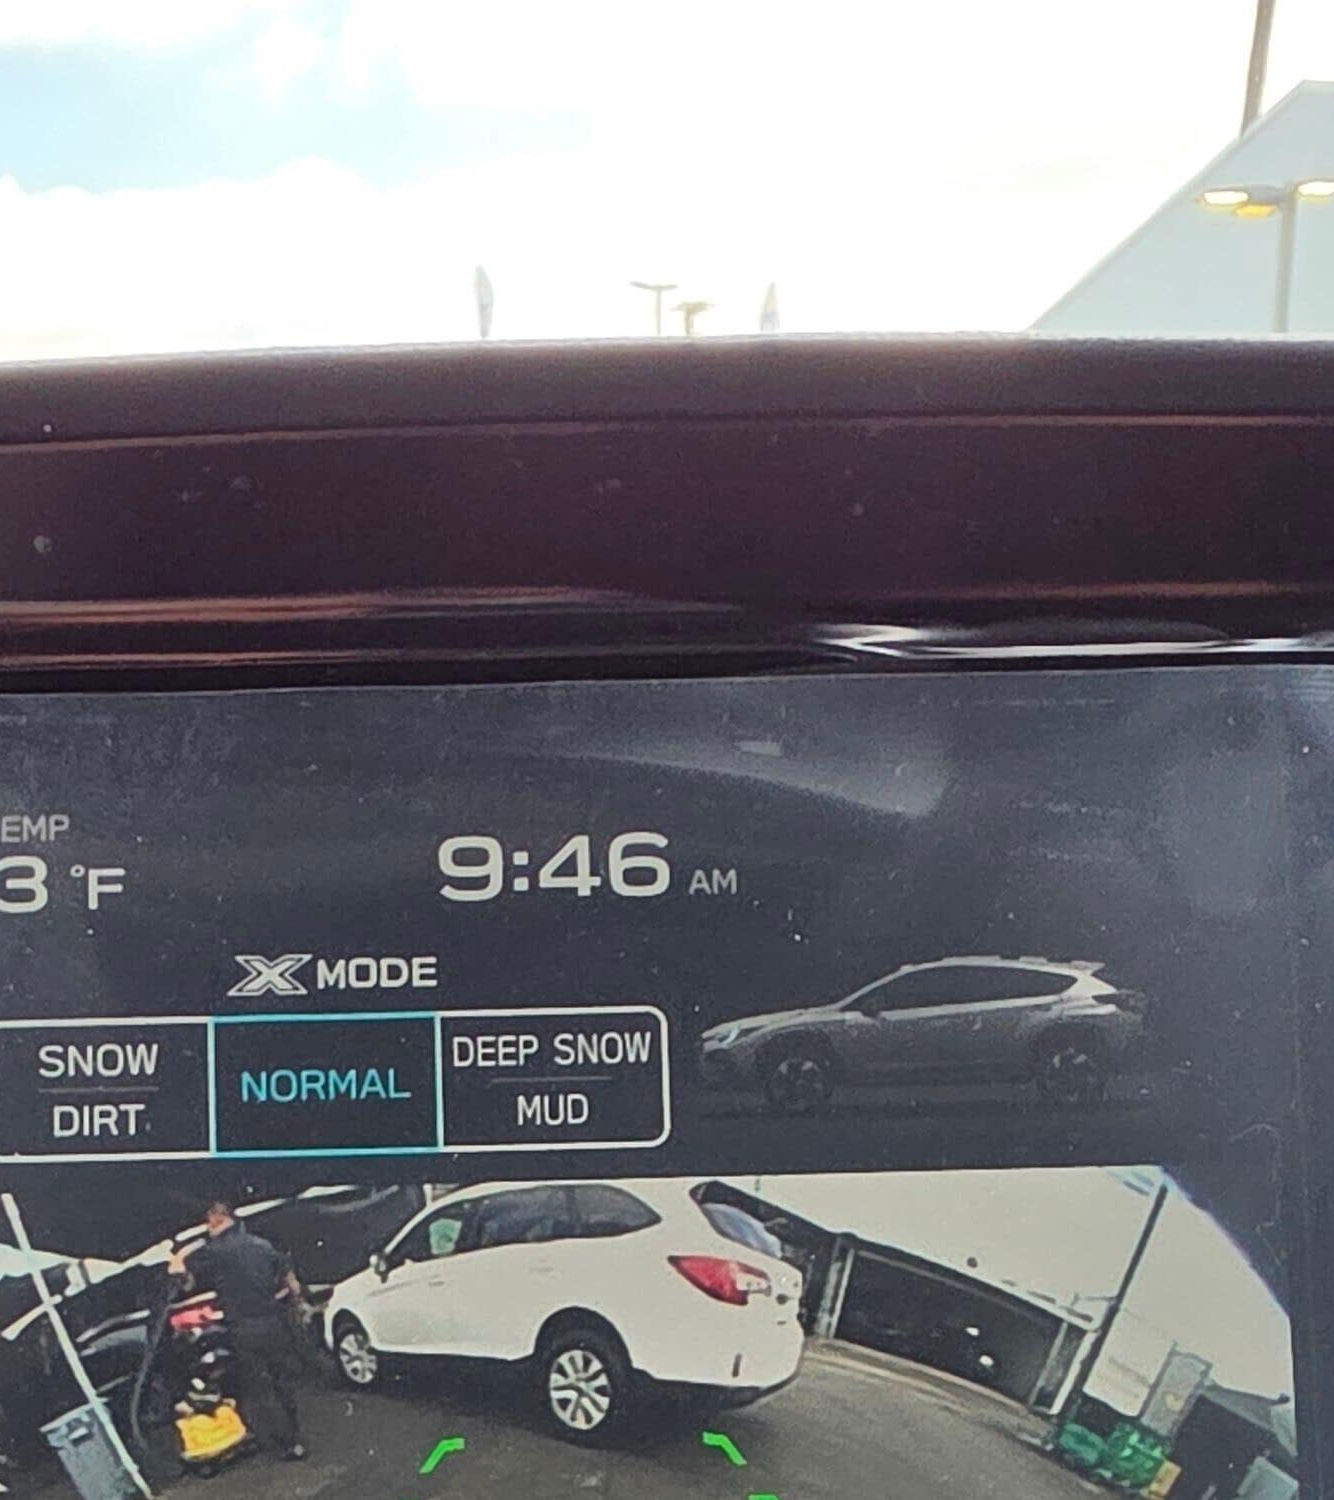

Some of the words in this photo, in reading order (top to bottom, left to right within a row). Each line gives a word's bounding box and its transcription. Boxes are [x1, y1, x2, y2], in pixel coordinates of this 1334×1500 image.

[438, 831, 670, 901] 9:46
[688, 868, 738, 895] AM
[317, 956, 438, 990] MODE
[38, 1042, 159, 1078] SNOW
[452, 1035, 539, 1067] DEEP
[553, 1031, 651, 1066] SNOW
[240, 1067, 412, 1103] NORMAL
[52, 1104, 147, 1138] DIRT
[517, 1093, 590, 1126] MUD
